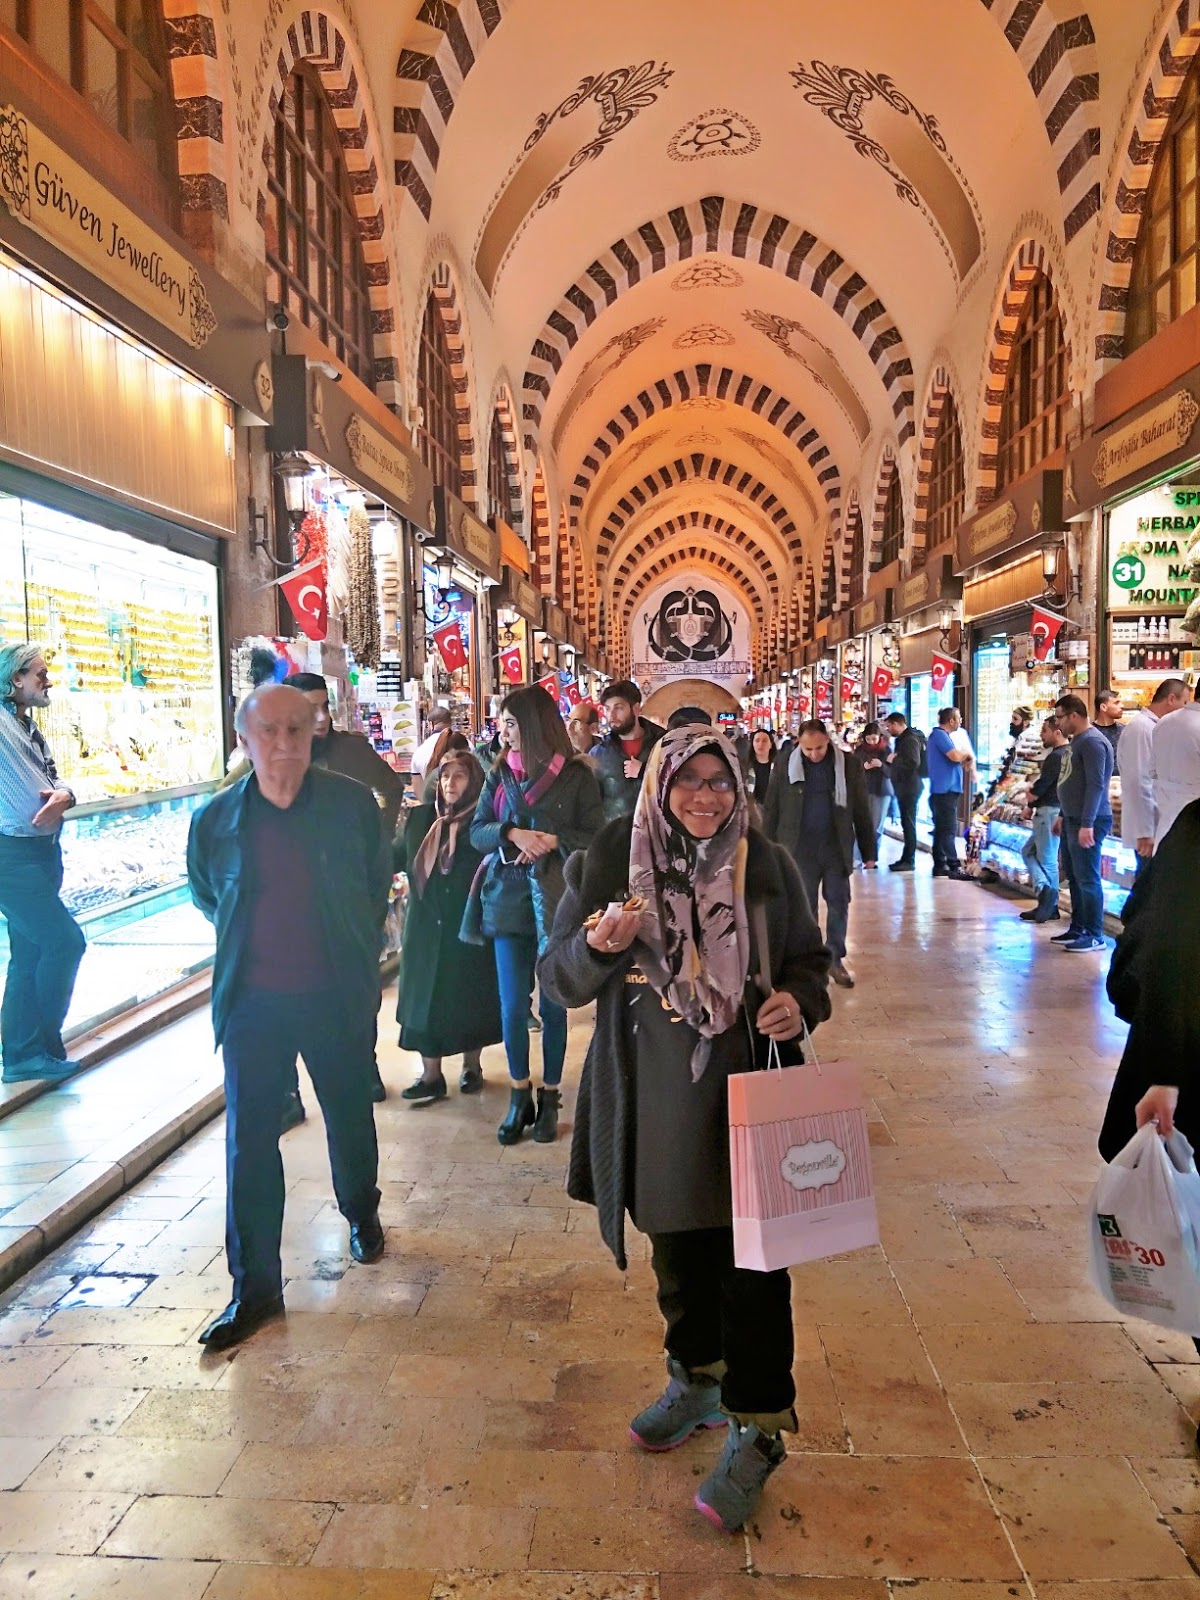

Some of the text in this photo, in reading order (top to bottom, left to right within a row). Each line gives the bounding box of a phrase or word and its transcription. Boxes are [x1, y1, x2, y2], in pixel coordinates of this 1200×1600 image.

[34, 161, 187, 317] Güven Jewellery
[1141, 412, 1176, 448] Baharat
[1118, 540, 1179, 555] AROMA
[1116, 561, 1142, 582] 31
[1135, 1246, 1165, 1266] 30
